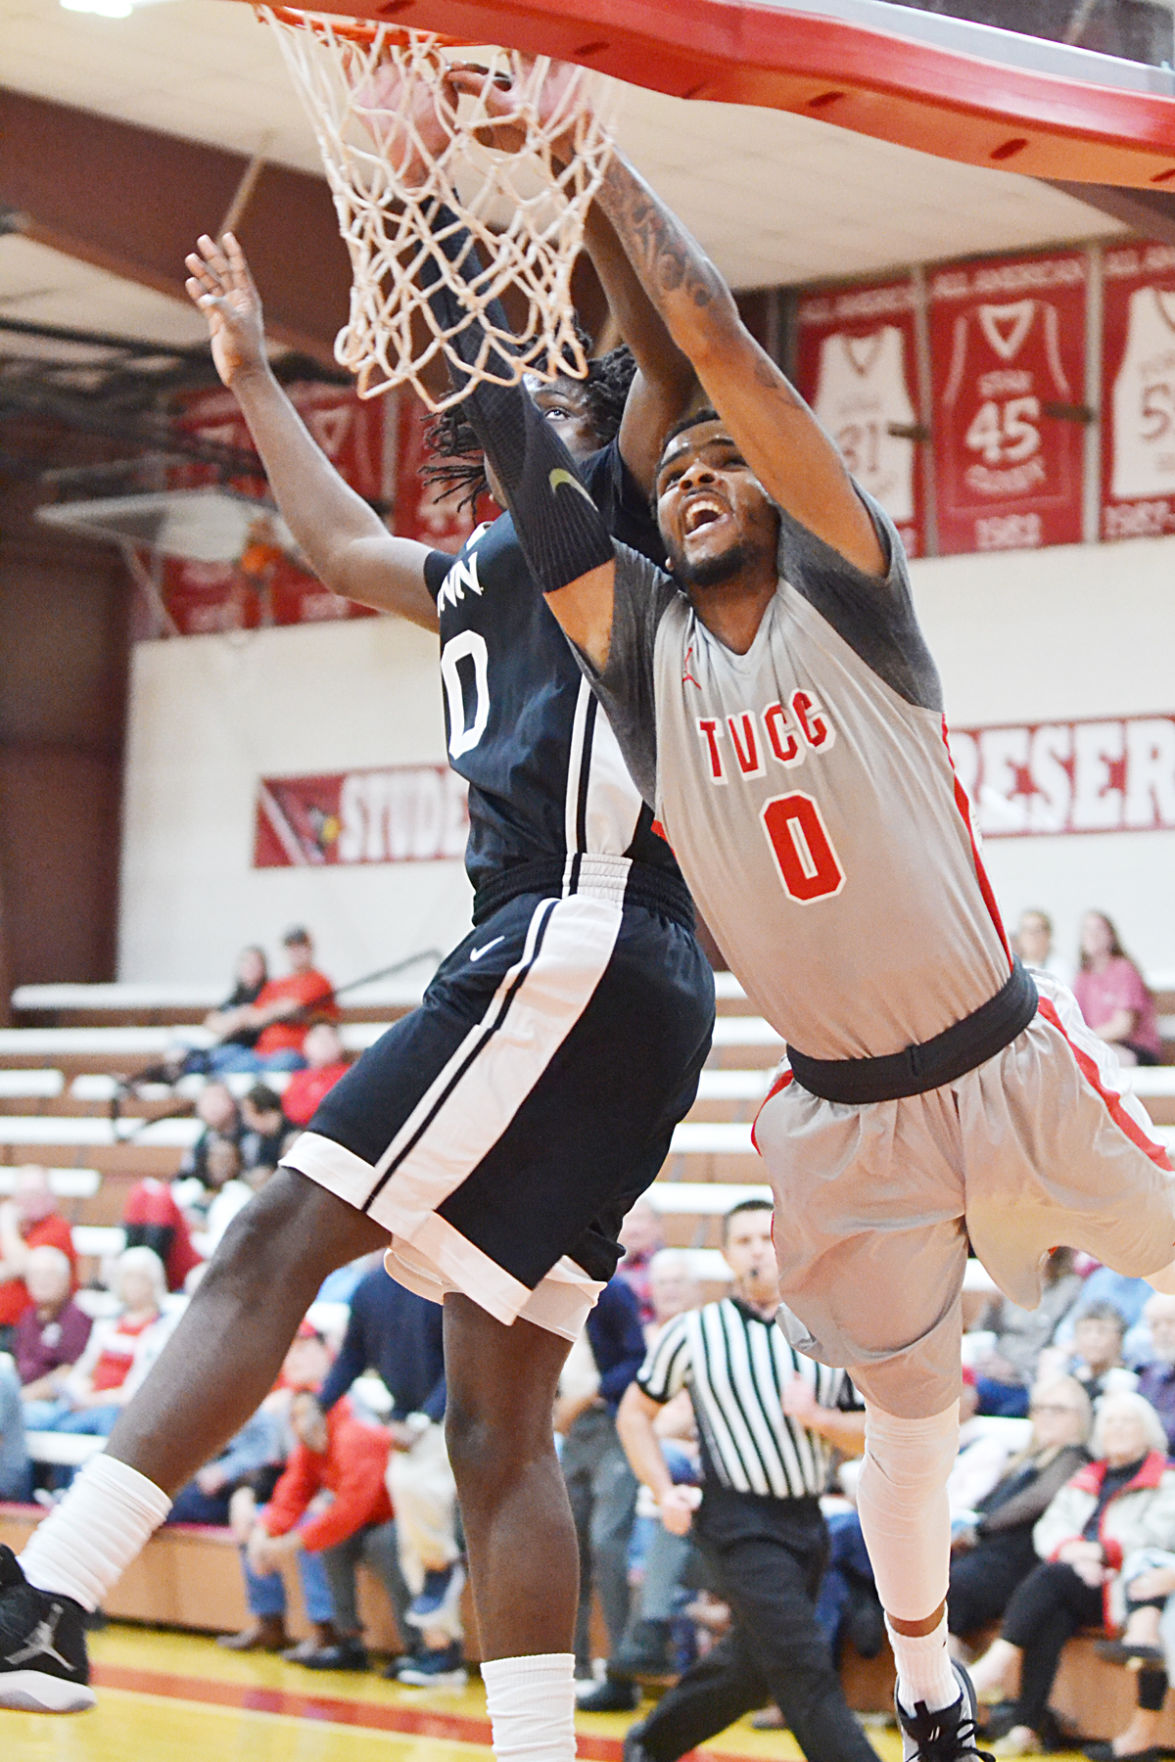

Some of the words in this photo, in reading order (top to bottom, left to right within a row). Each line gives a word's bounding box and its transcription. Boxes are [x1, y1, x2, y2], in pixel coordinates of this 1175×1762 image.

[965, 397, 1040, 463] 45
[440, 629, 490, 760] 0
[696, 688, 837, 786] TVCC
[759, 789, 847, 906] 0
